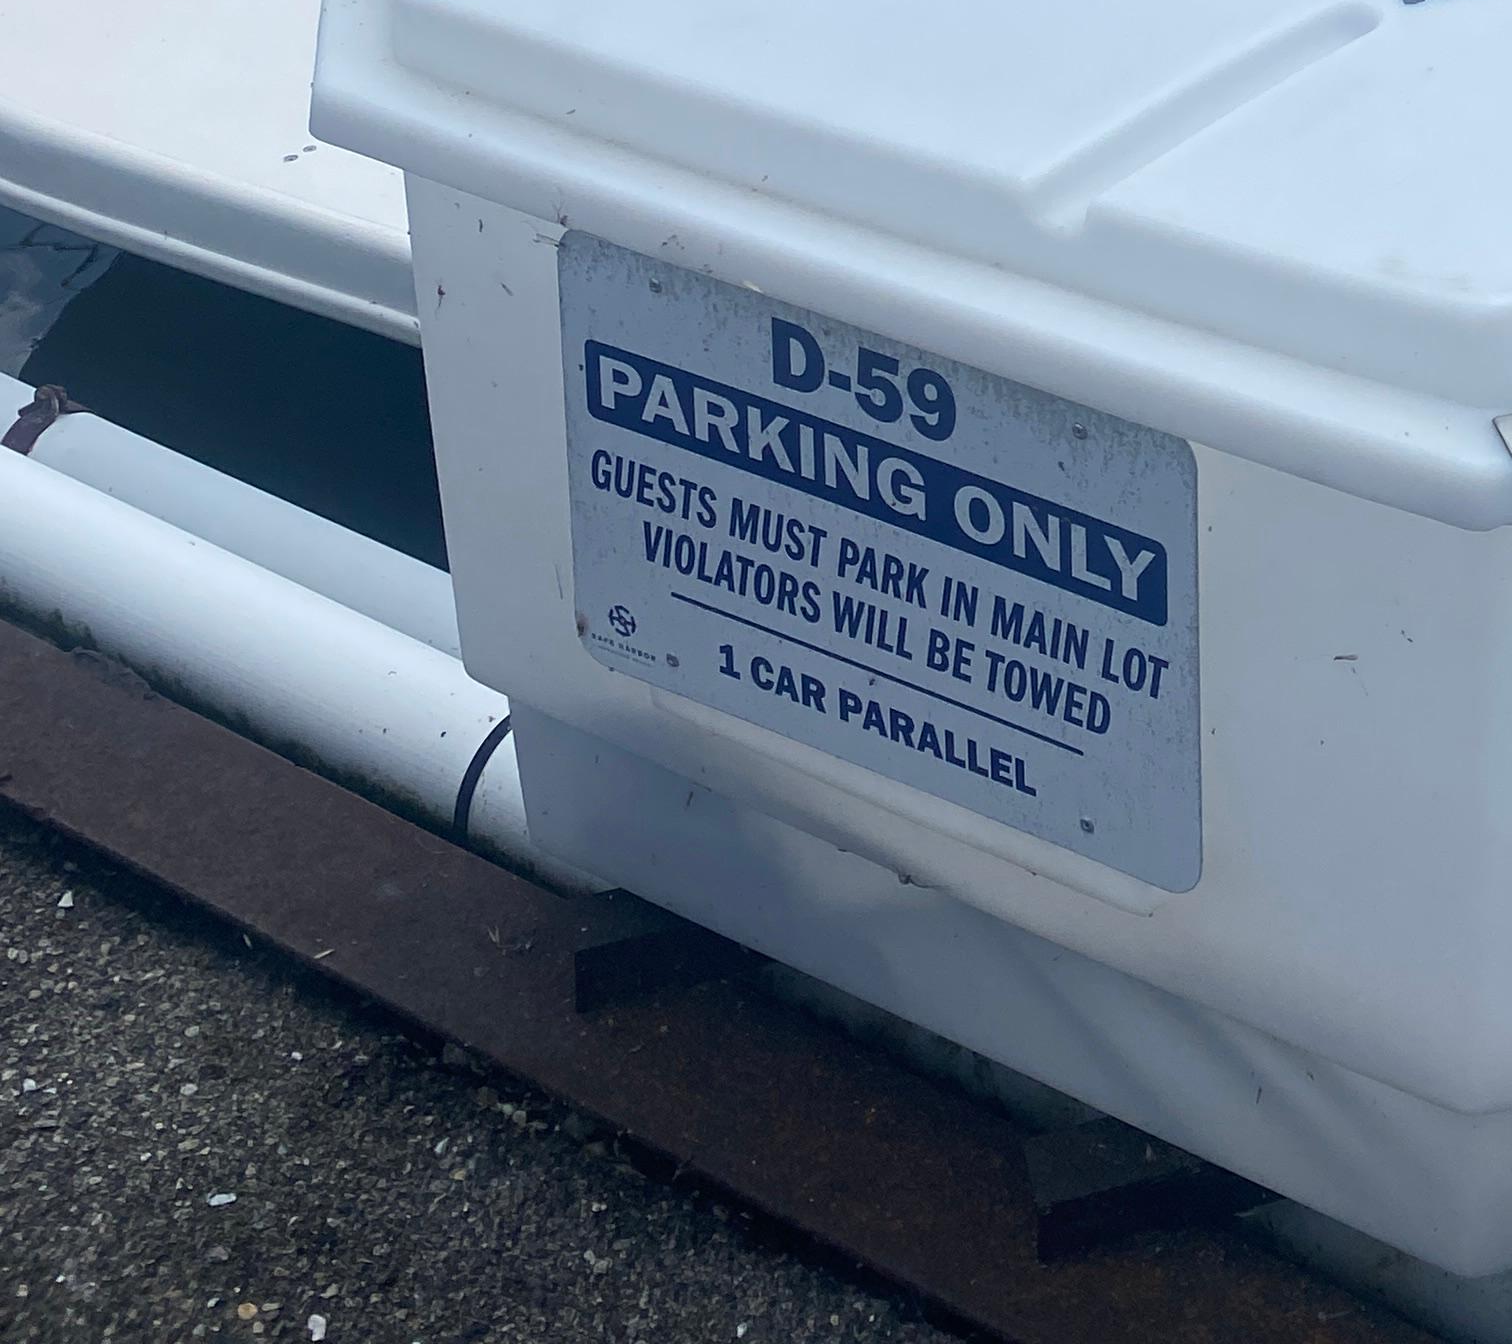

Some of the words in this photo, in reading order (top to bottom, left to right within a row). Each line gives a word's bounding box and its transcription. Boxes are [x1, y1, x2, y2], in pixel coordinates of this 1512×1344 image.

[600, 354, 926, 522] PARKING
[954, 484, 1156, 602] ONLY
[771, 317, 956, 441] D-59
[591, 449, 716, 528] GUESTS
[730, 497, 827, 567] MUST
[838, 540, 927, 608] PARK
[942, 576, 976, 627] IN
[992, 594, 1091, 669] MAIN
[1102, 641, 1169, 699] LOT
[643, 521, 821, 623] VIOLATORS
[833, 593, 912, 661] WILL
[929, 629, 973, 680] BE
[986, 657, 1111, 736] TOWED
[719, 644, 741, 681] 1
[752, 655, 827, 714] CAR
[838, 691, 1037, 796] PARALLEL
